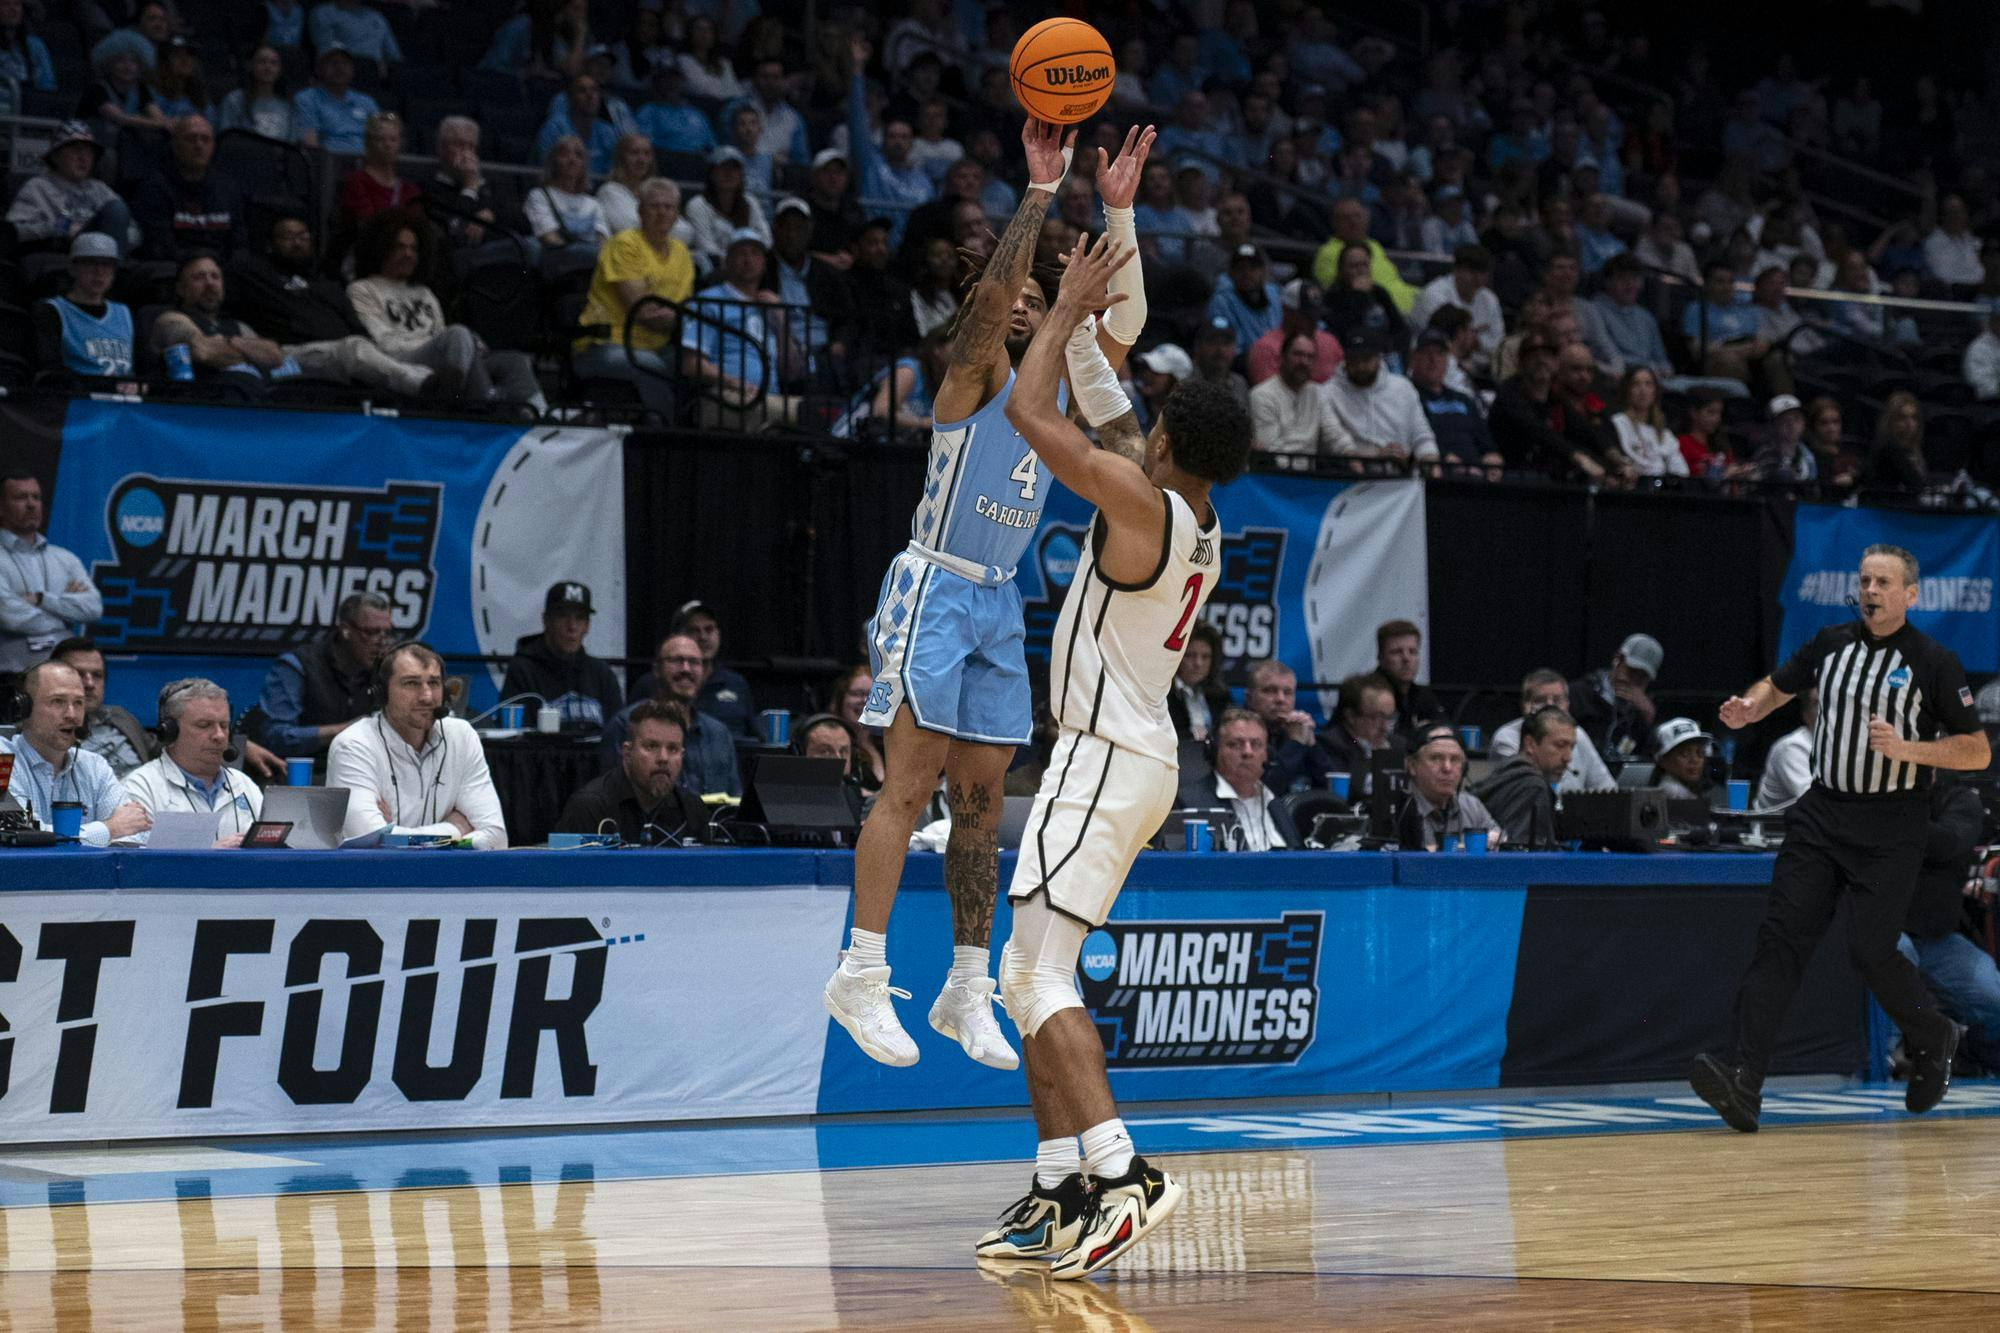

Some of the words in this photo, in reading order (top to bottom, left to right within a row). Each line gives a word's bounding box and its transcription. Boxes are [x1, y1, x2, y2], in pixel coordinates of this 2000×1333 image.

[1044, 65, 1110, 86] Wilson
[1009, 448, 1038, 501] 4
[165, 492, 351, 561] MARCH
[564, 584, 583, 602] M
[1164, 572, 1204, 652] 2
[1084, 954, 1117, 969] NCAA
[1118, 931, 1253, 987] MARCH
[176, 917, 610, 1110] FOUR
[1133, 987, 1313, 1045] MADNESS
